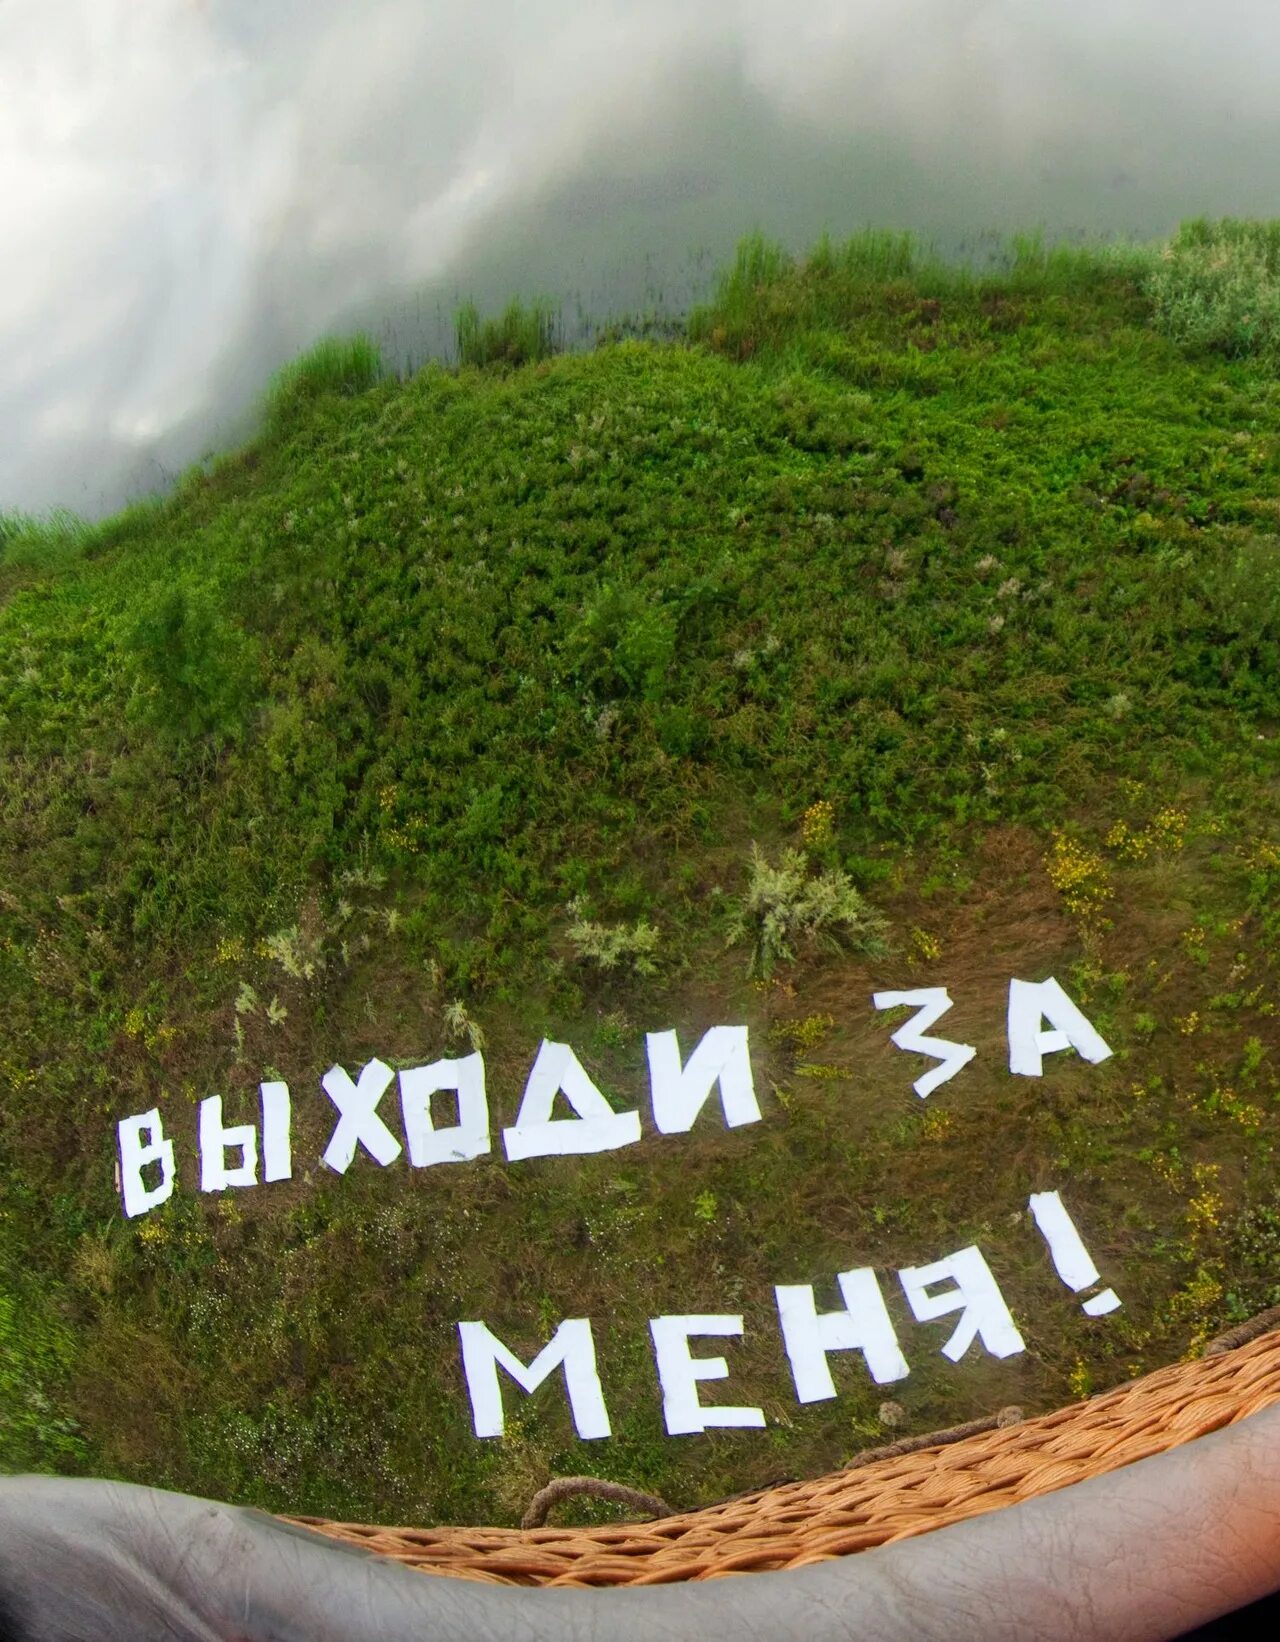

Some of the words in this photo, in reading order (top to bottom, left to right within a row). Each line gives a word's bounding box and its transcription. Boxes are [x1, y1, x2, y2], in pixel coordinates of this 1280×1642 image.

[118, 1025, 762, 1218] ВЫХОДИ
[872, 976, 1113, 1099] ЗА
[458, 1190, 1122, 1440] МЕНЯ!
